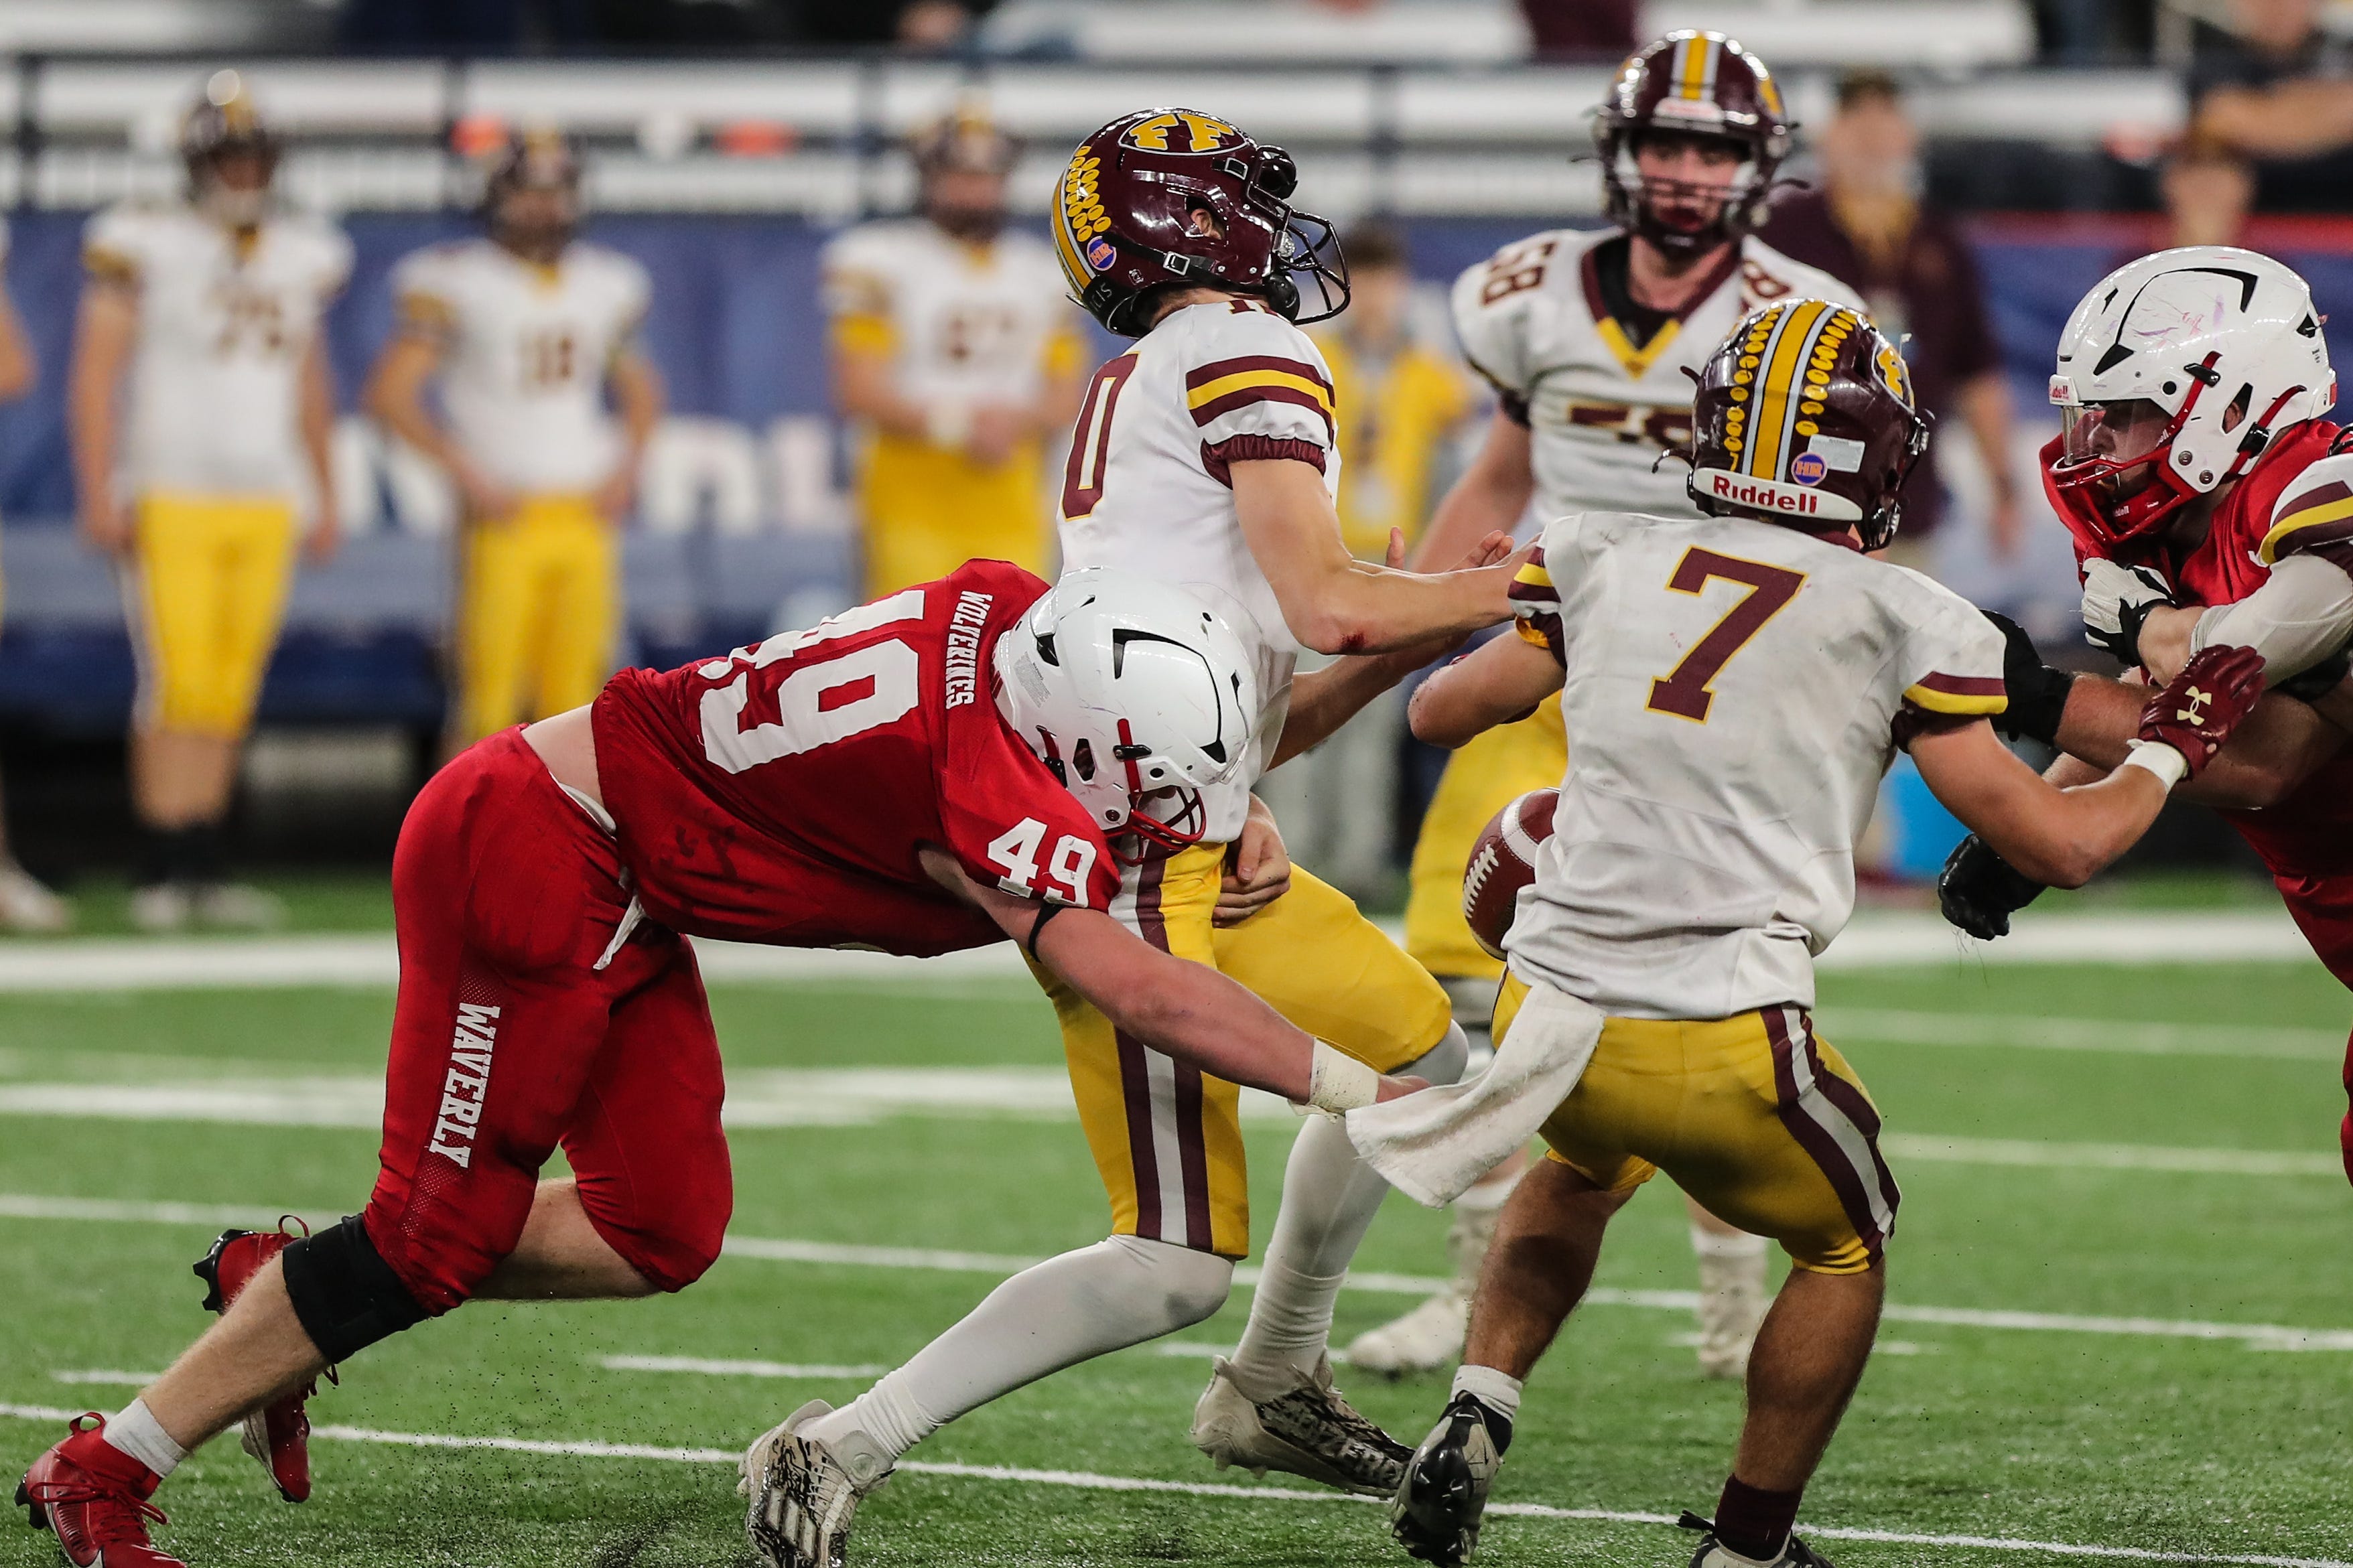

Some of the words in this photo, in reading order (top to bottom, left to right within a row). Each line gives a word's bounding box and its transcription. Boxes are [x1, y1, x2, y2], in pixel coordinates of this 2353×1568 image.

[1129, 113, 1235, 152] FF
[1090, 242, 1113, 266] HR
[1712, 474, 1818, 514] Riddell
[1796, 461, 1822, 478] HR
[945, 590, 993, 710] WOLVERINES
[1644, 544, 1810, 725] 7
[987, 816, 1097, 908] 49
[428, 1002, 501, 1169] WAVERLY
